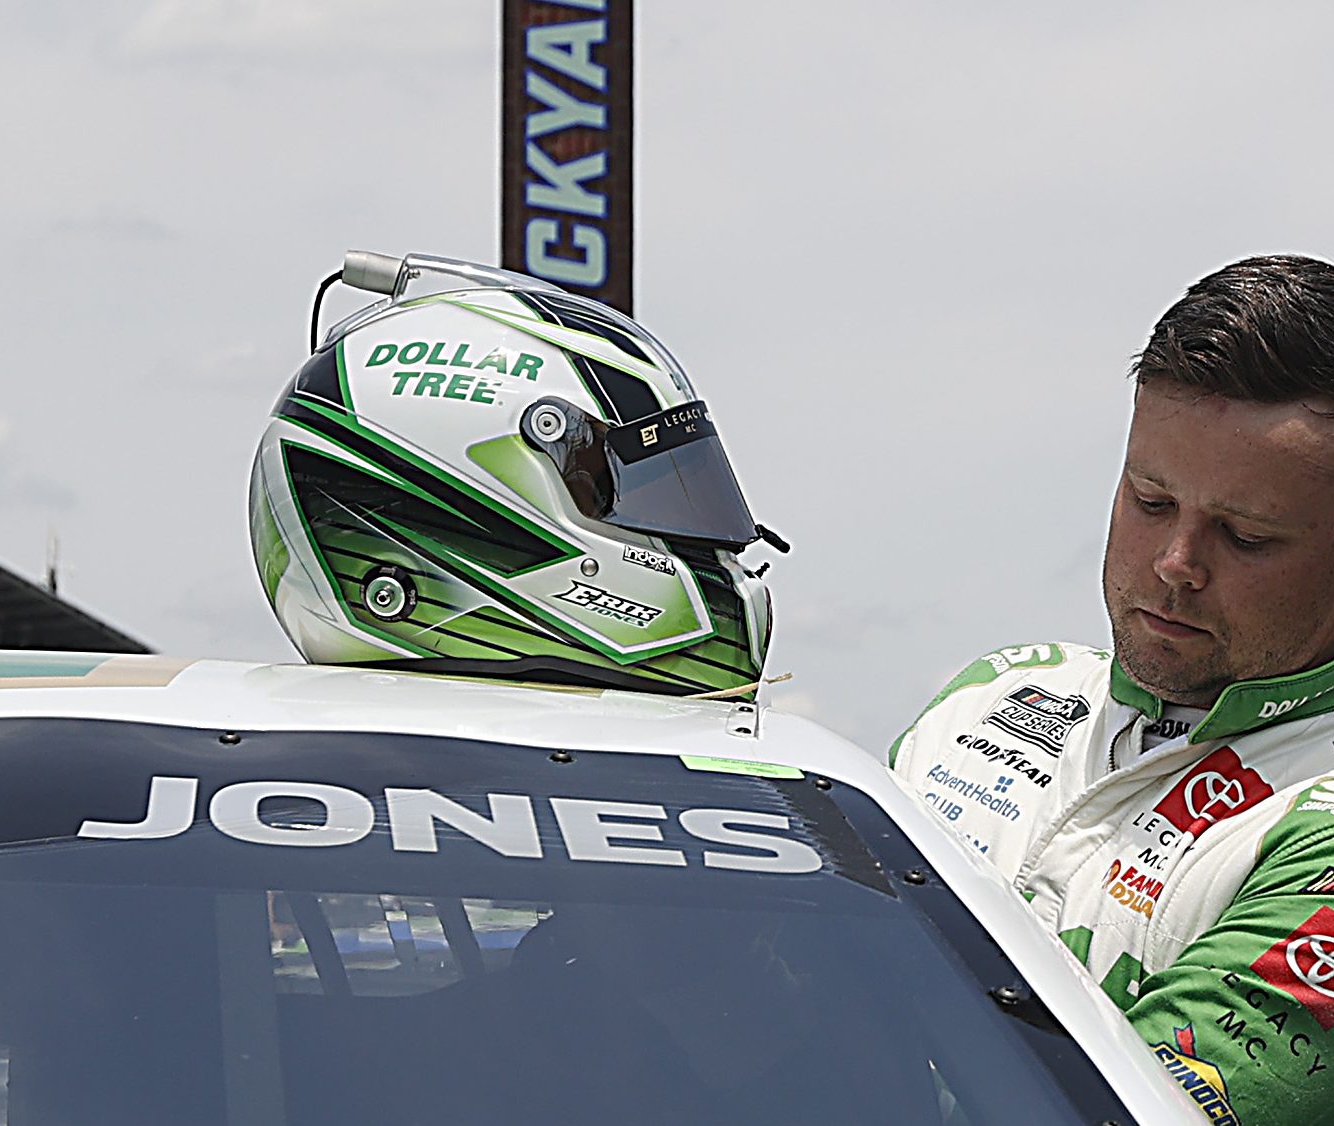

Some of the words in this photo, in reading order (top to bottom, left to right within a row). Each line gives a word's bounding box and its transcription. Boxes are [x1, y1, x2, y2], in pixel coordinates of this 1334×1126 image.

[525, 0, 607, 288] CKYA
[364, 341, 545, 382] DOLLAR
[391, 371, 504, 405] TREE
[663, 407, 702, 428] LEGACY
[563, 582, 662, 622] ERIK
[1001, 705, 1033, 721] CUP
[1024, 716, 1067, 741] SERIES
[927, 764, 1021, 822] AdventHealth
[78, 775, 824, 875] JONES
[1207, 963, 1327, 1077] EGACY
[1215, 1009, 1268, 1068] M.C.
